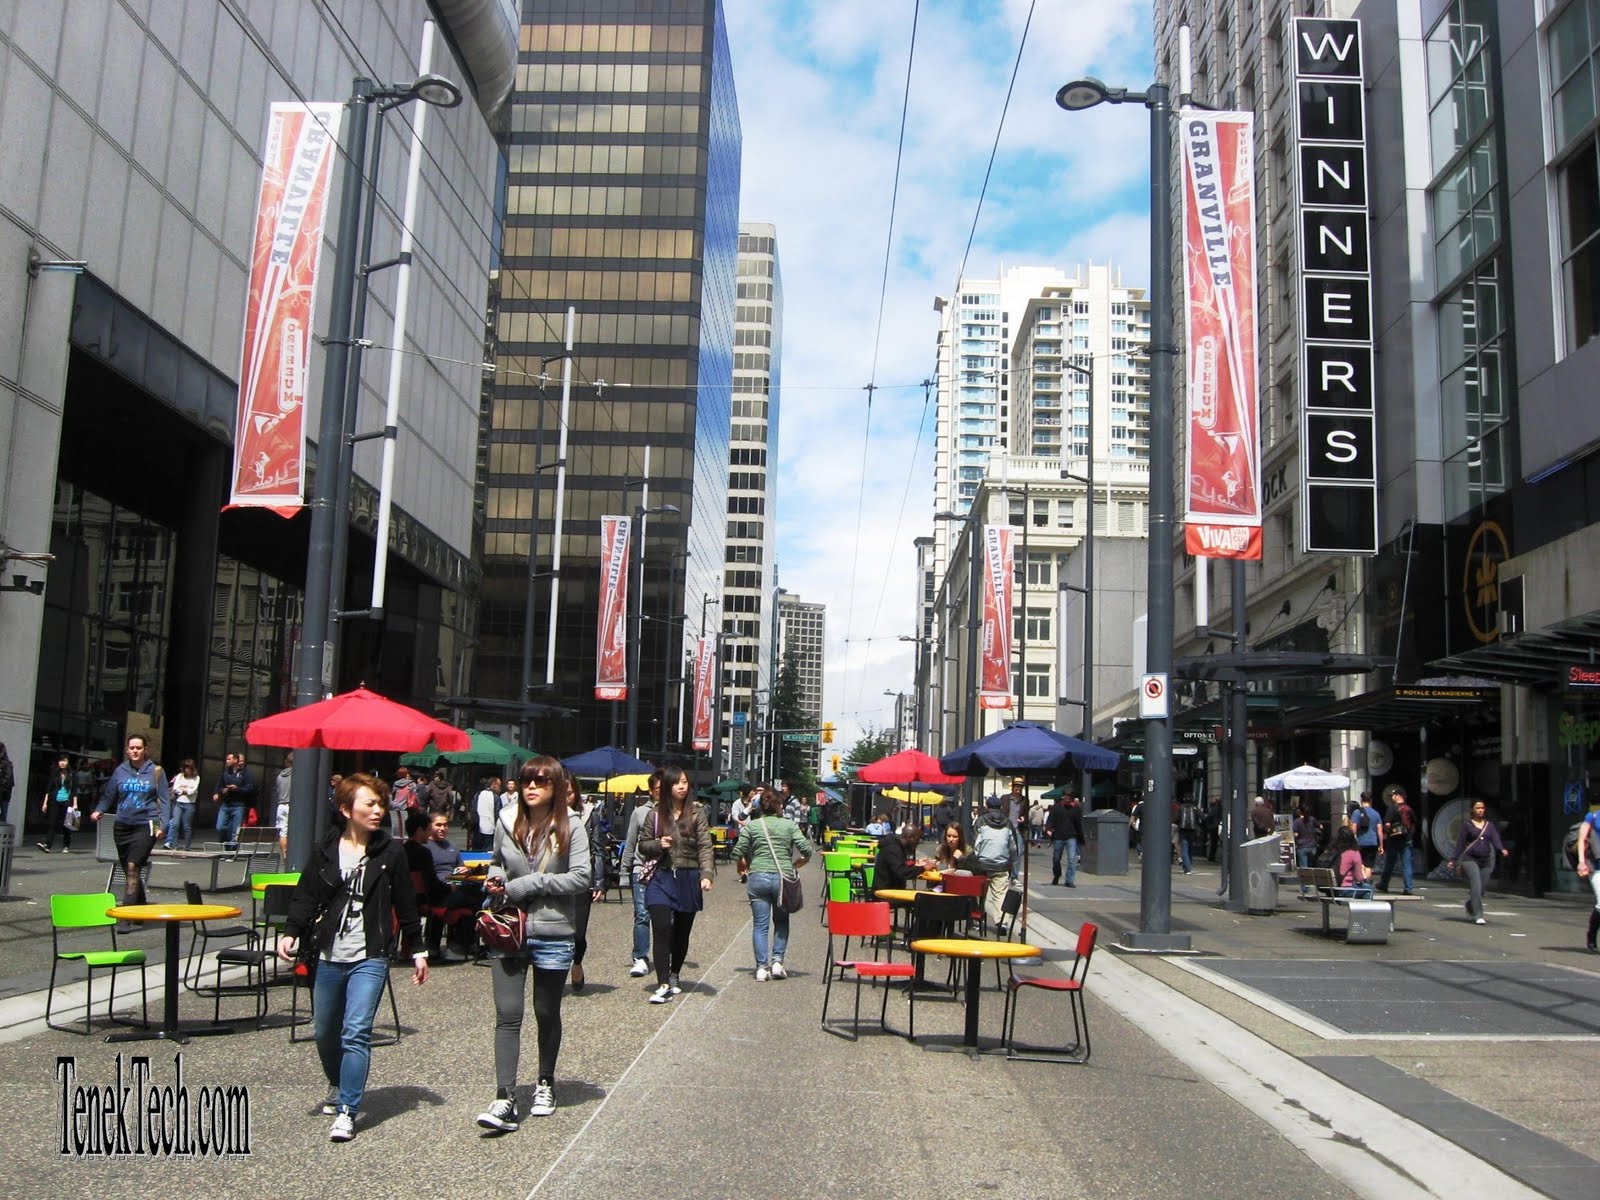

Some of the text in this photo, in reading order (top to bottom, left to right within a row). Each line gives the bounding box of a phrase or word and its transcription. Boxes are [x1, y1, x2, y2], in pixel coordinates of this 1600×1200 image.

[1188, 120, 1231, 286] GRANVILLE
[1301, 32, 1358, 463] WINNERS
[1201, 340, 1212, 419] ORPHEUM
[988, 528, 1004, 597] GRANVILLE
[1196, 525, 1233, 549] VIVA
[1431, 689, 1474, 697] CANADIENNE
